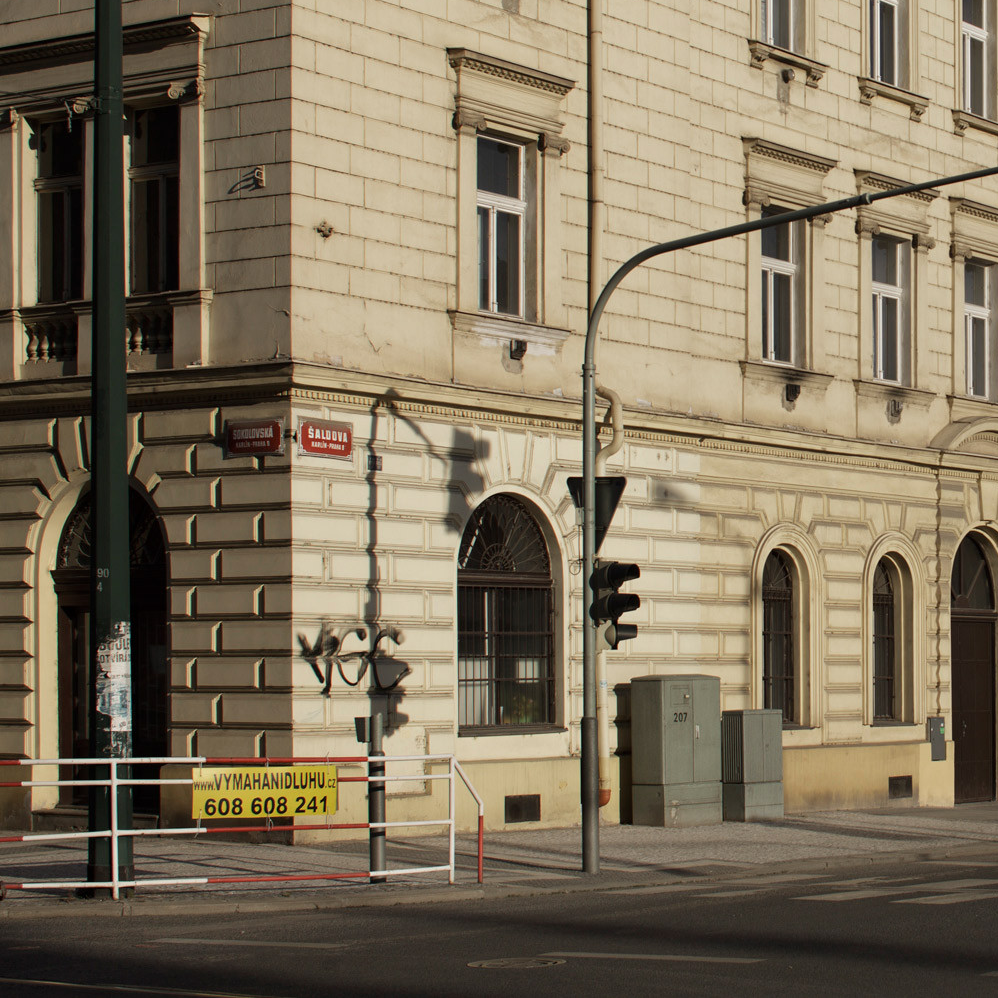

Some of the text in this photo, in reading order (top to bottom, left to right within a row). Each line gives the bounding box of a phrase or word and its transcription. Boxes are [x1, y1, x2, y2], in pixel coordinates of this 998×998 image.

[233, 426, 274, 440] SOKOLOVSKÁ
[308, 426, 348, 443] ŠALDOVA
[97, 568, 110, 578] 90
[97, 582, 103, 592] 4
[673, 712, 688, 723] 207
[194, 772, 336, 791] www.VYMAHANIDLUHU.cz
[205, 796, 327, 816] 608 608 241
